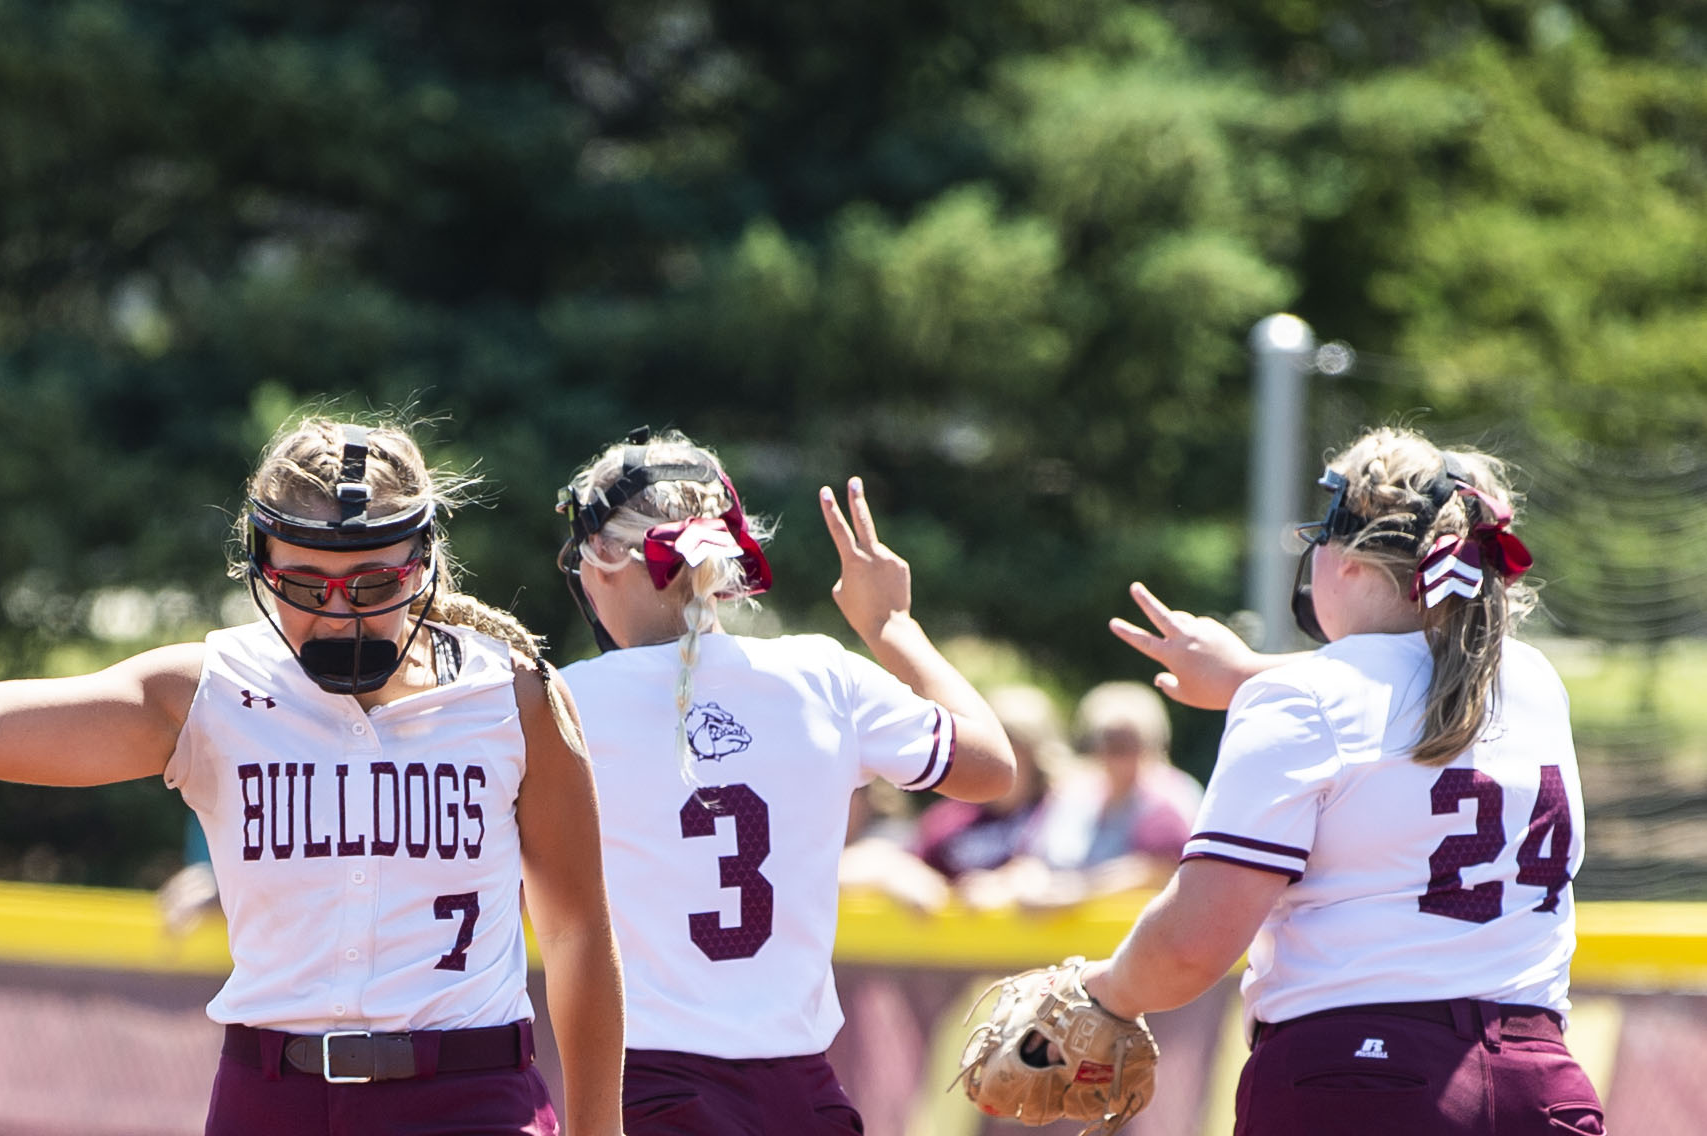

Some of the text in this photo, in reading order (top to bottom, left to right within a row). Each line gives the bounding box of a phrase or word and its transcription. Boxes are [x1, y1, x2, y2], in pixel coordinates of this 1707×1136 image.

[237, 761, 486, 861] BULLDOGS
[679, 783, 774, 961] 3
[1418, 765, 1571, 924] 24
[433, 891, 480, 971] 7
